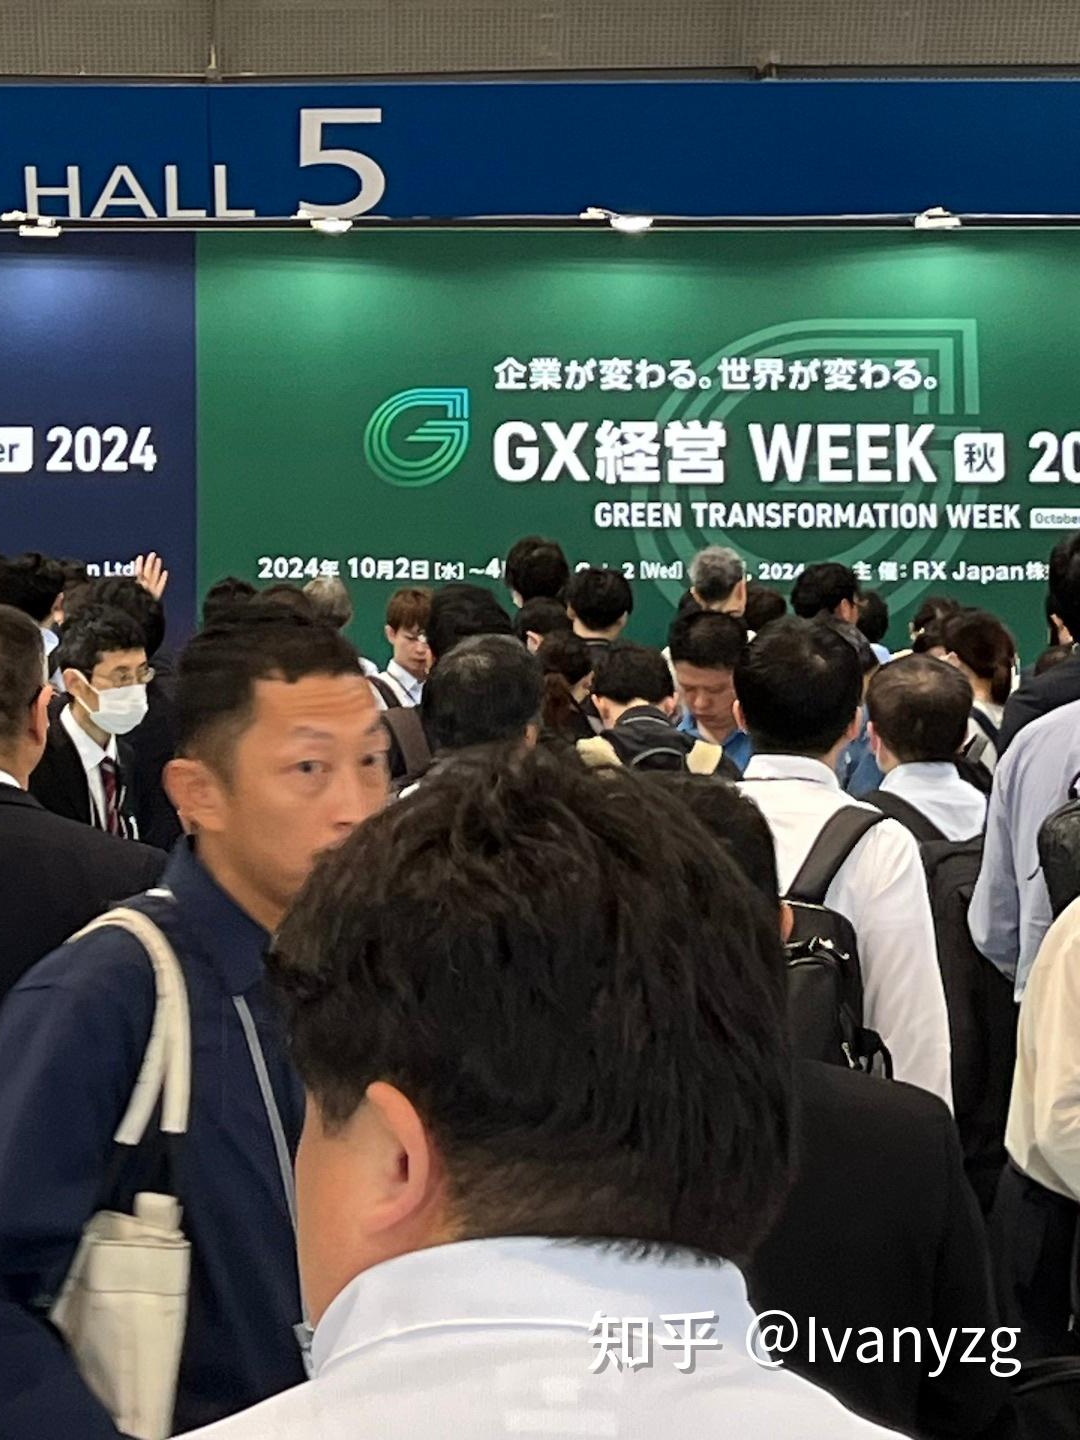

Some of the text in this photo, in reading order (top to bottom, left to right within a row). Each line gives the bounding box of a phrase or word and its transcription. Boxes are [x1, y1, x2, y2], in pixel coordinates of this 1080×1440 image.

[24, 107, 386, 220] HALL 5
[45, 426, 158, 472] 2024
[748, 423, 938, 484] WEEK
[962, 443, 998, 475] 秋
[594, 501, 683, 530] GREEN
[690, 502, 938, 530] TRANSFORMATION
[946, 503, 1022, 530] WEEK
[912, 561, 947, 581] RX
